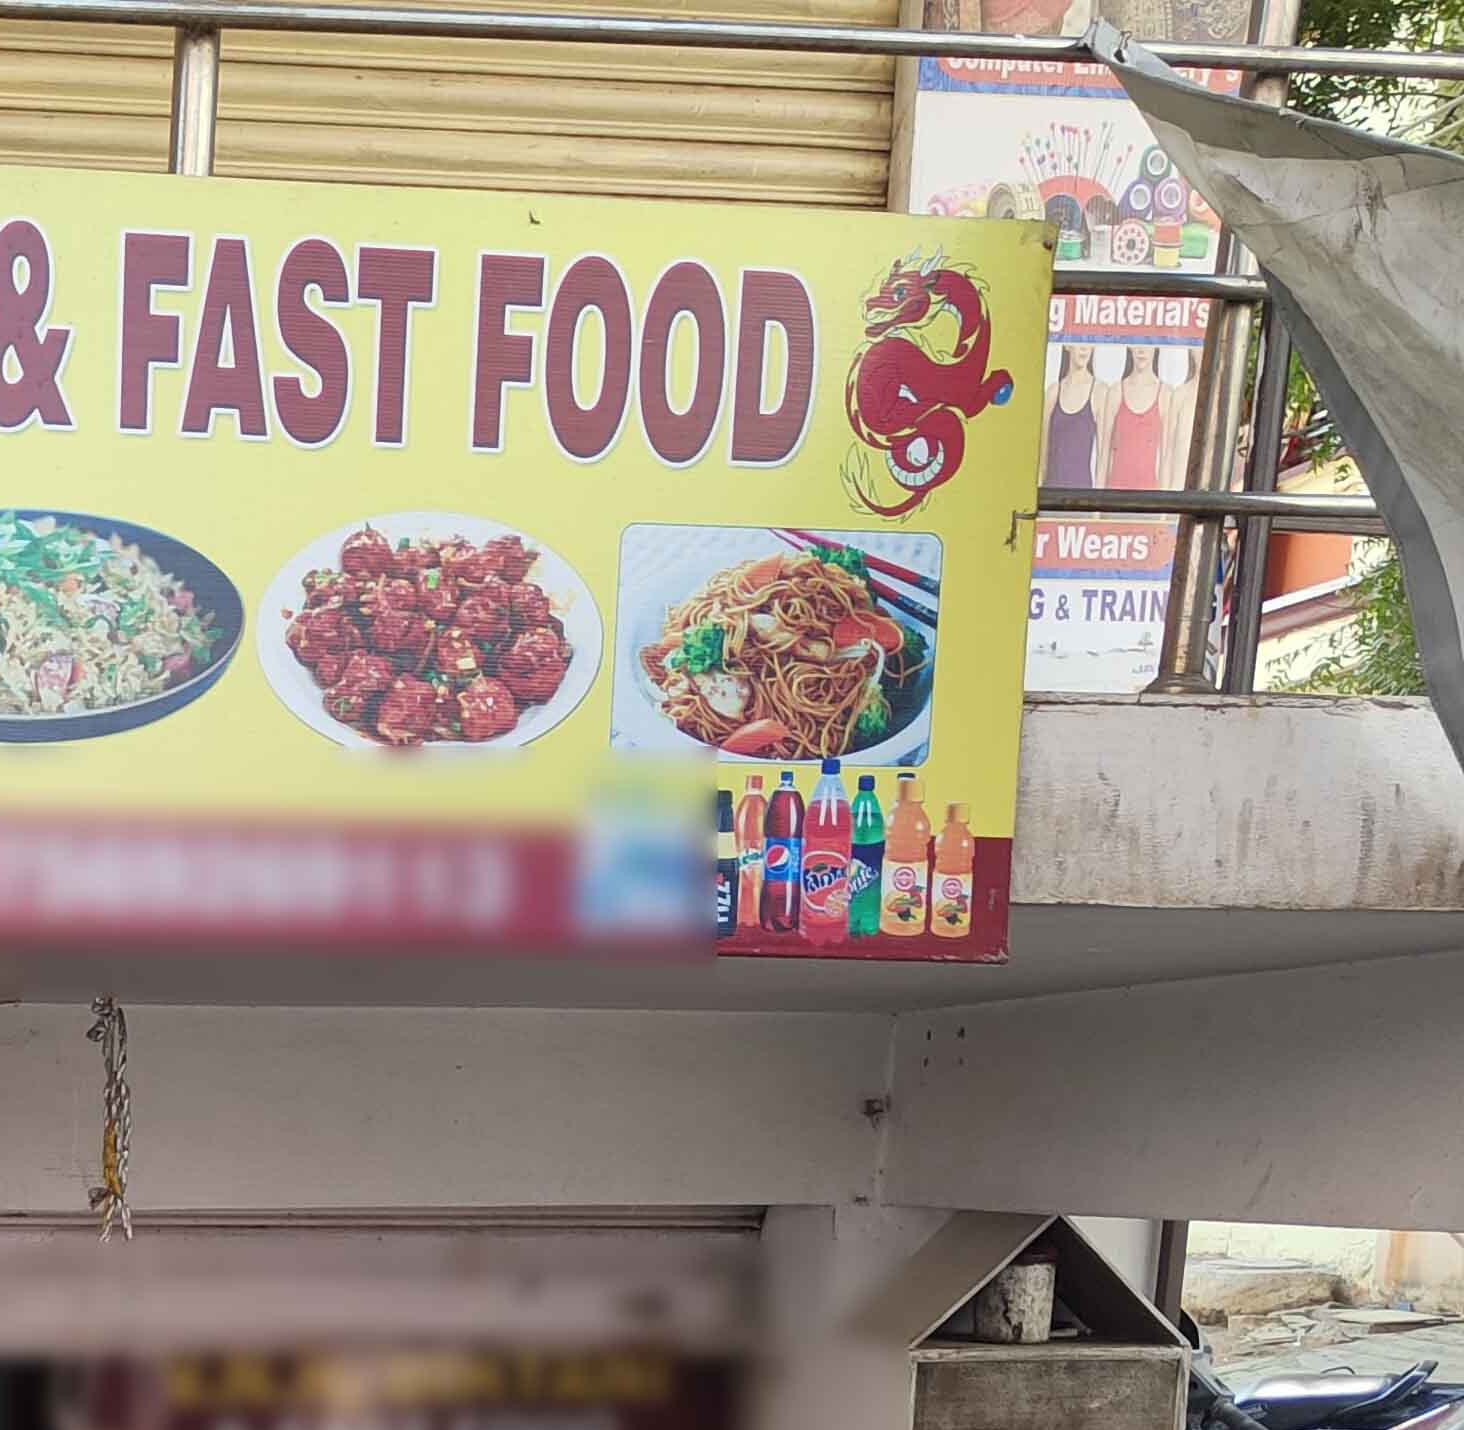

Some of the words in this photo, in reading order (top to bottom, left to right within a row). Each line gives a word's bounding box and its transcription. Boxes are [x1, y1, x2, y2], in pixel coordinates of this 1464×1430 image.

[117, 230, 437, 446] FAST
[470, 252, 816, 467] FOOD
[1057, 526, 1149, 560] Wears
[1055, 594, 1070, 620] &
[1082, 589, 1169, 622] TRAIN
